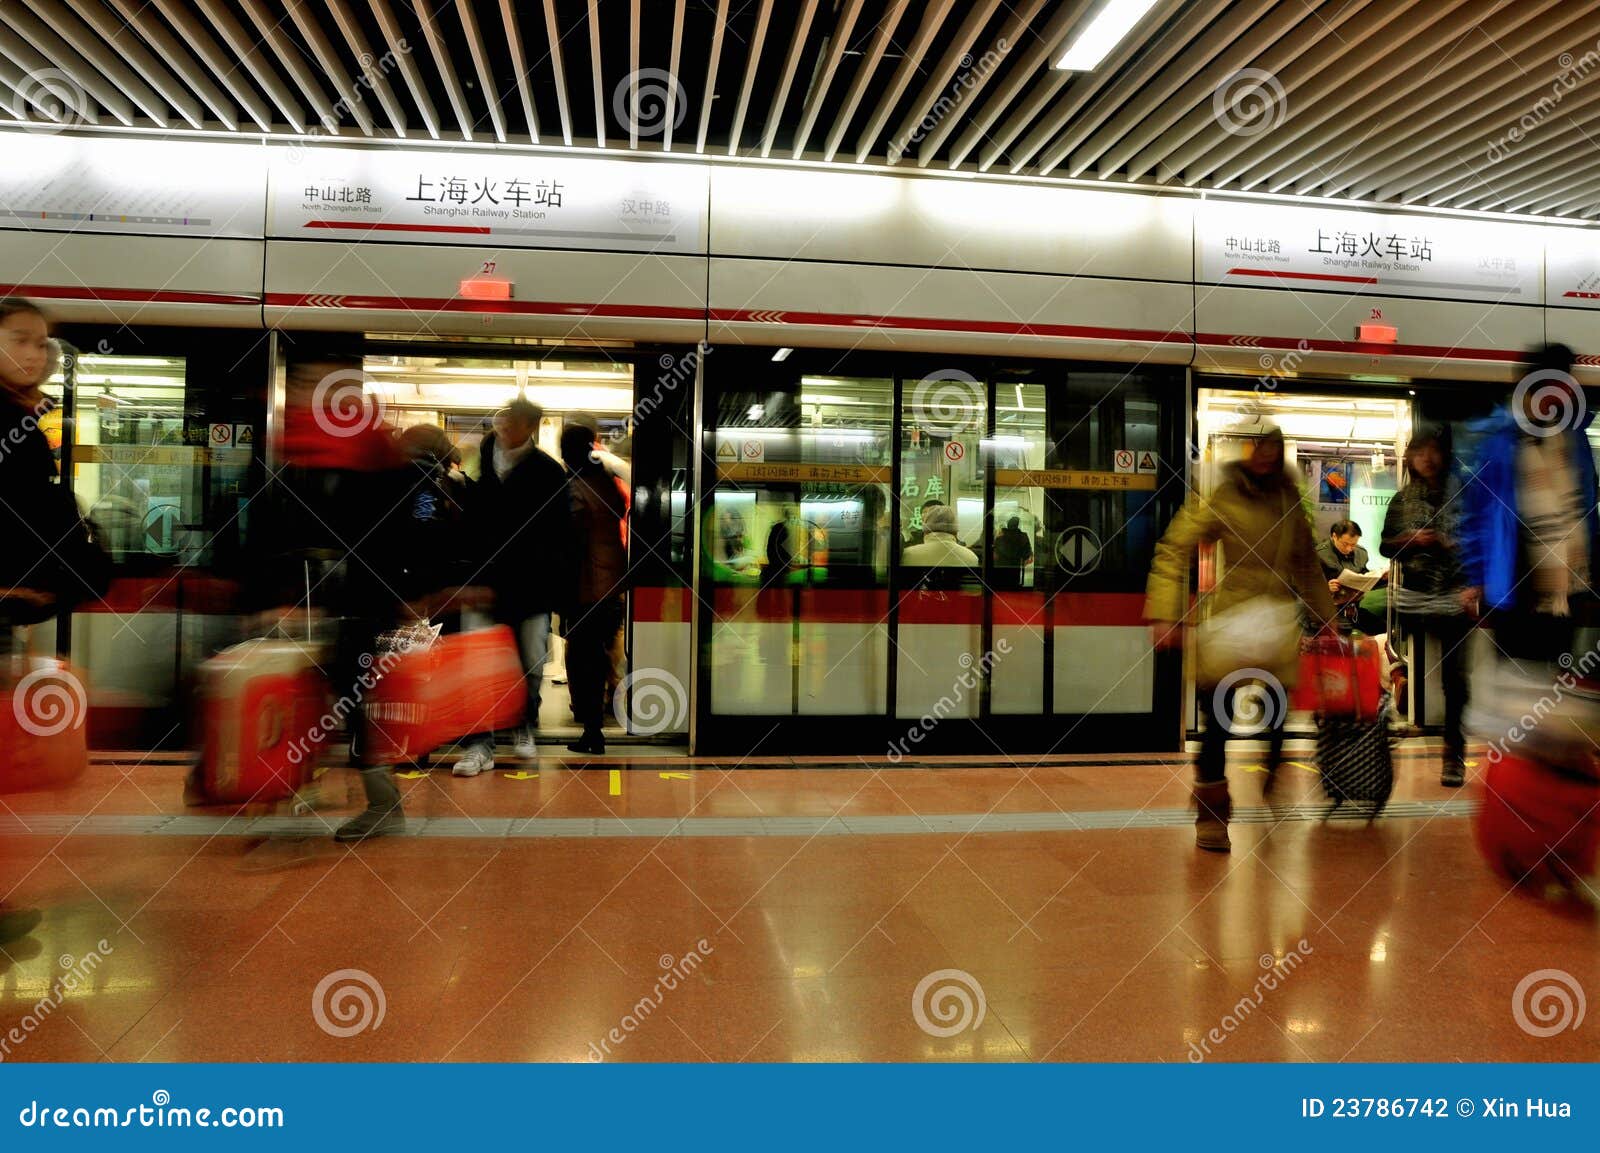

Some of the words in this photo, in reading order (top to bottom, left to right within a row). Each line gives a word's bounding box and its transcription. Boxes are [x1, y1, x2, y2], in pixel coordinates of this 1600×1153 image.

[304, 185, 372, 204] 中山北路
[406, 174, 564, 207] 上海火车站
[302, 203, 321, 211] North
[323, 204, 362, 213] Zhongshan
[364, 205, 382, 213] Road
[424, 206, 469, 218] Shanghai
[472, 207, 509, 219] Railway
[512, 209, 546, 219] Station
[621, 199, 671, 216] 汉中路
[1226, 236, 1280, 254] 中山北路
[1308, 228, 1432, 261] 上海火车站
[483, 262, 496, 274] 27
[1323, 257, 1360, 268] Shanghai
[1361, 260, 1391, 270] Railway
[1393, 261, 1420, 271] Station
[1371, 308, 1382, 319] 28
[901, 476, 945, 499] 石库
